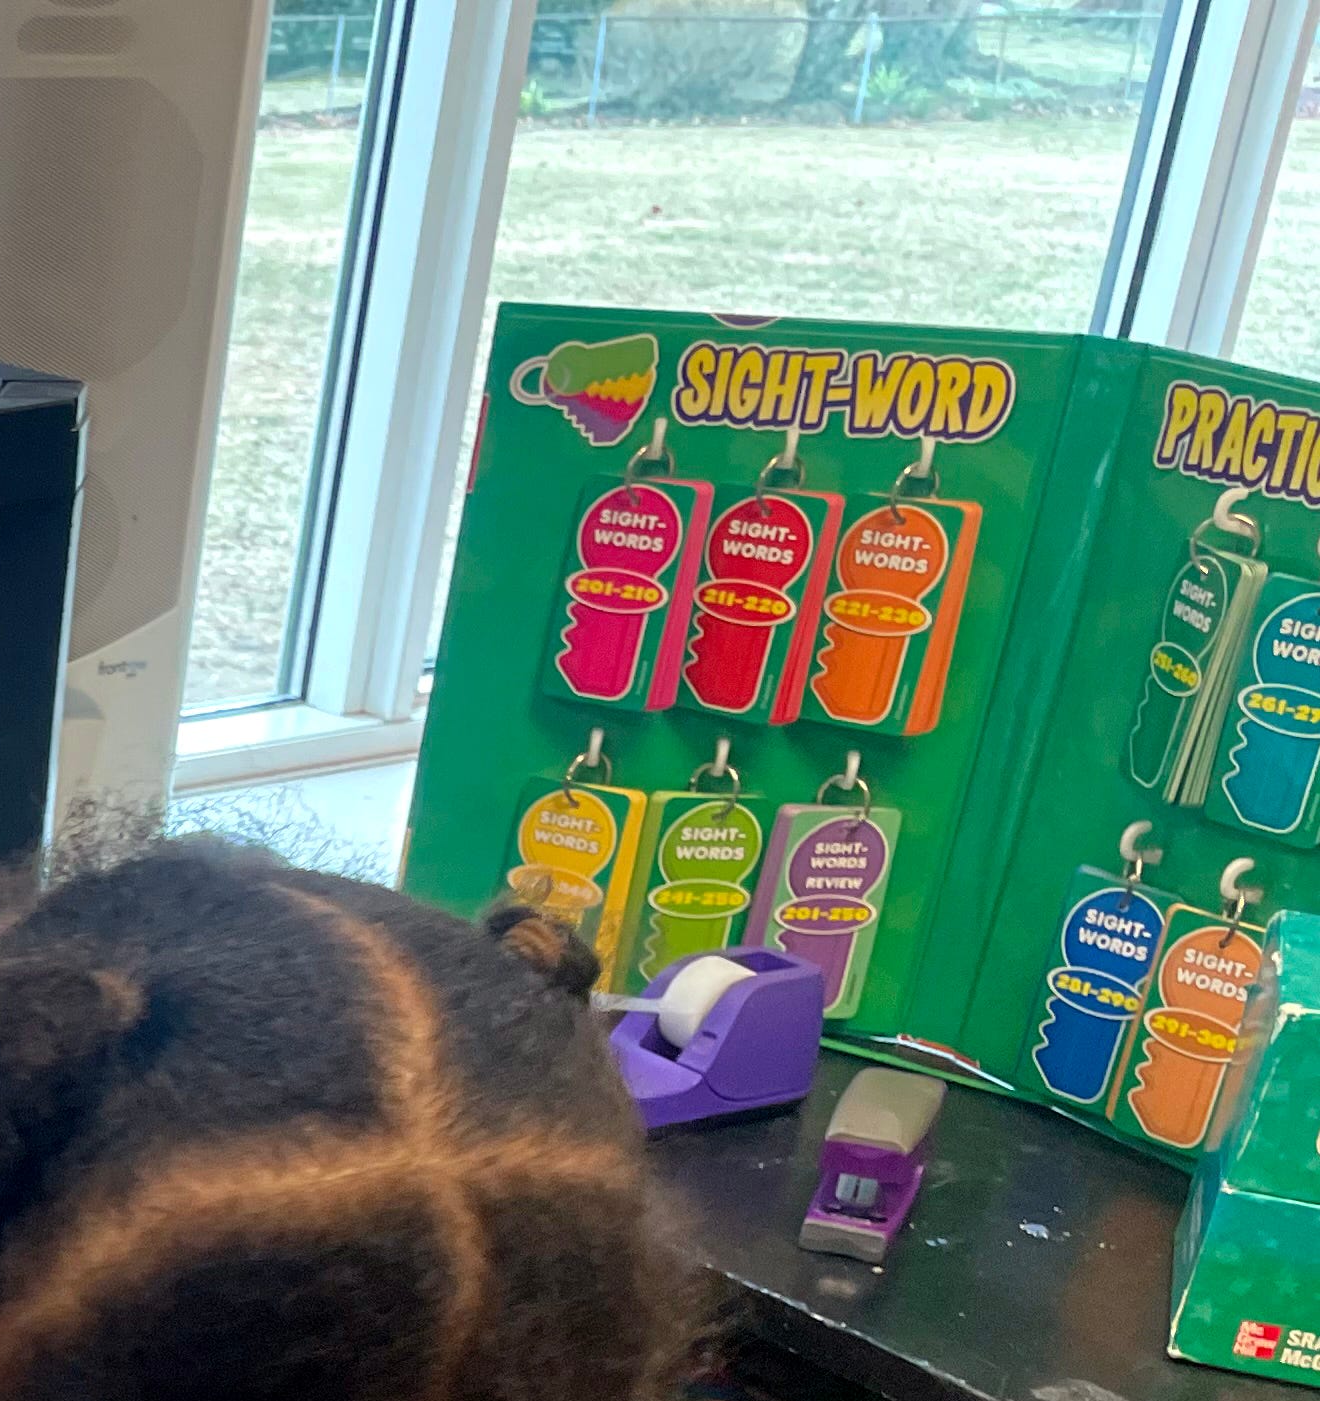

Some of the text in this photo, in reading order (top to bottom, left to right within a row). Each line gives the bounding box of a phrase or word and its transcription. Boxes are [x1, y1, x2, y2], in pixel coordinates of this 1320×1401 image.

[679, 343, 1012, 442] SIGHT-WORD
[599, 509, 666, 531] SIGHT-
[728, 519, 797, 542] SIGHT-
[593, 528, 664, 553] WORDS
[723, 539, 794, 565] WORDS
[861, 529, 931, 552] SIGHT-
[855, 549, 928, 574] WORDS
[575, 577, 660, 603] 201-210
[703, 588, 788, 616] 211-220
[1180, 578, 1217, 609] SIGHT-
[831, 599, 925, 626] 221-230
[1172, 599, 1212, 633] WORDS
[1279, 617, 1320, 642] SIG
[540, 810, 600, 834] SIGHT-
[680, 827, 747, 843] SIGHT-
[534, 828, 600, 855] WORDS
[675, 846, 745, 861] WORDS
[815, 842, 869, 856] SIGHT-
[810, 856, 867, 870] WORDS
[805, 876, 864, 890] REVIEW
[1085, 908, 1153, 940] SIGHT-
[1078, 926, 1148, 962] WORDS
[1183, 947, 1255, 979] SIGHT-
[1055, 973, 1140, 1013] 281-290
[1176, 966, 1249, 1002] WORDS
